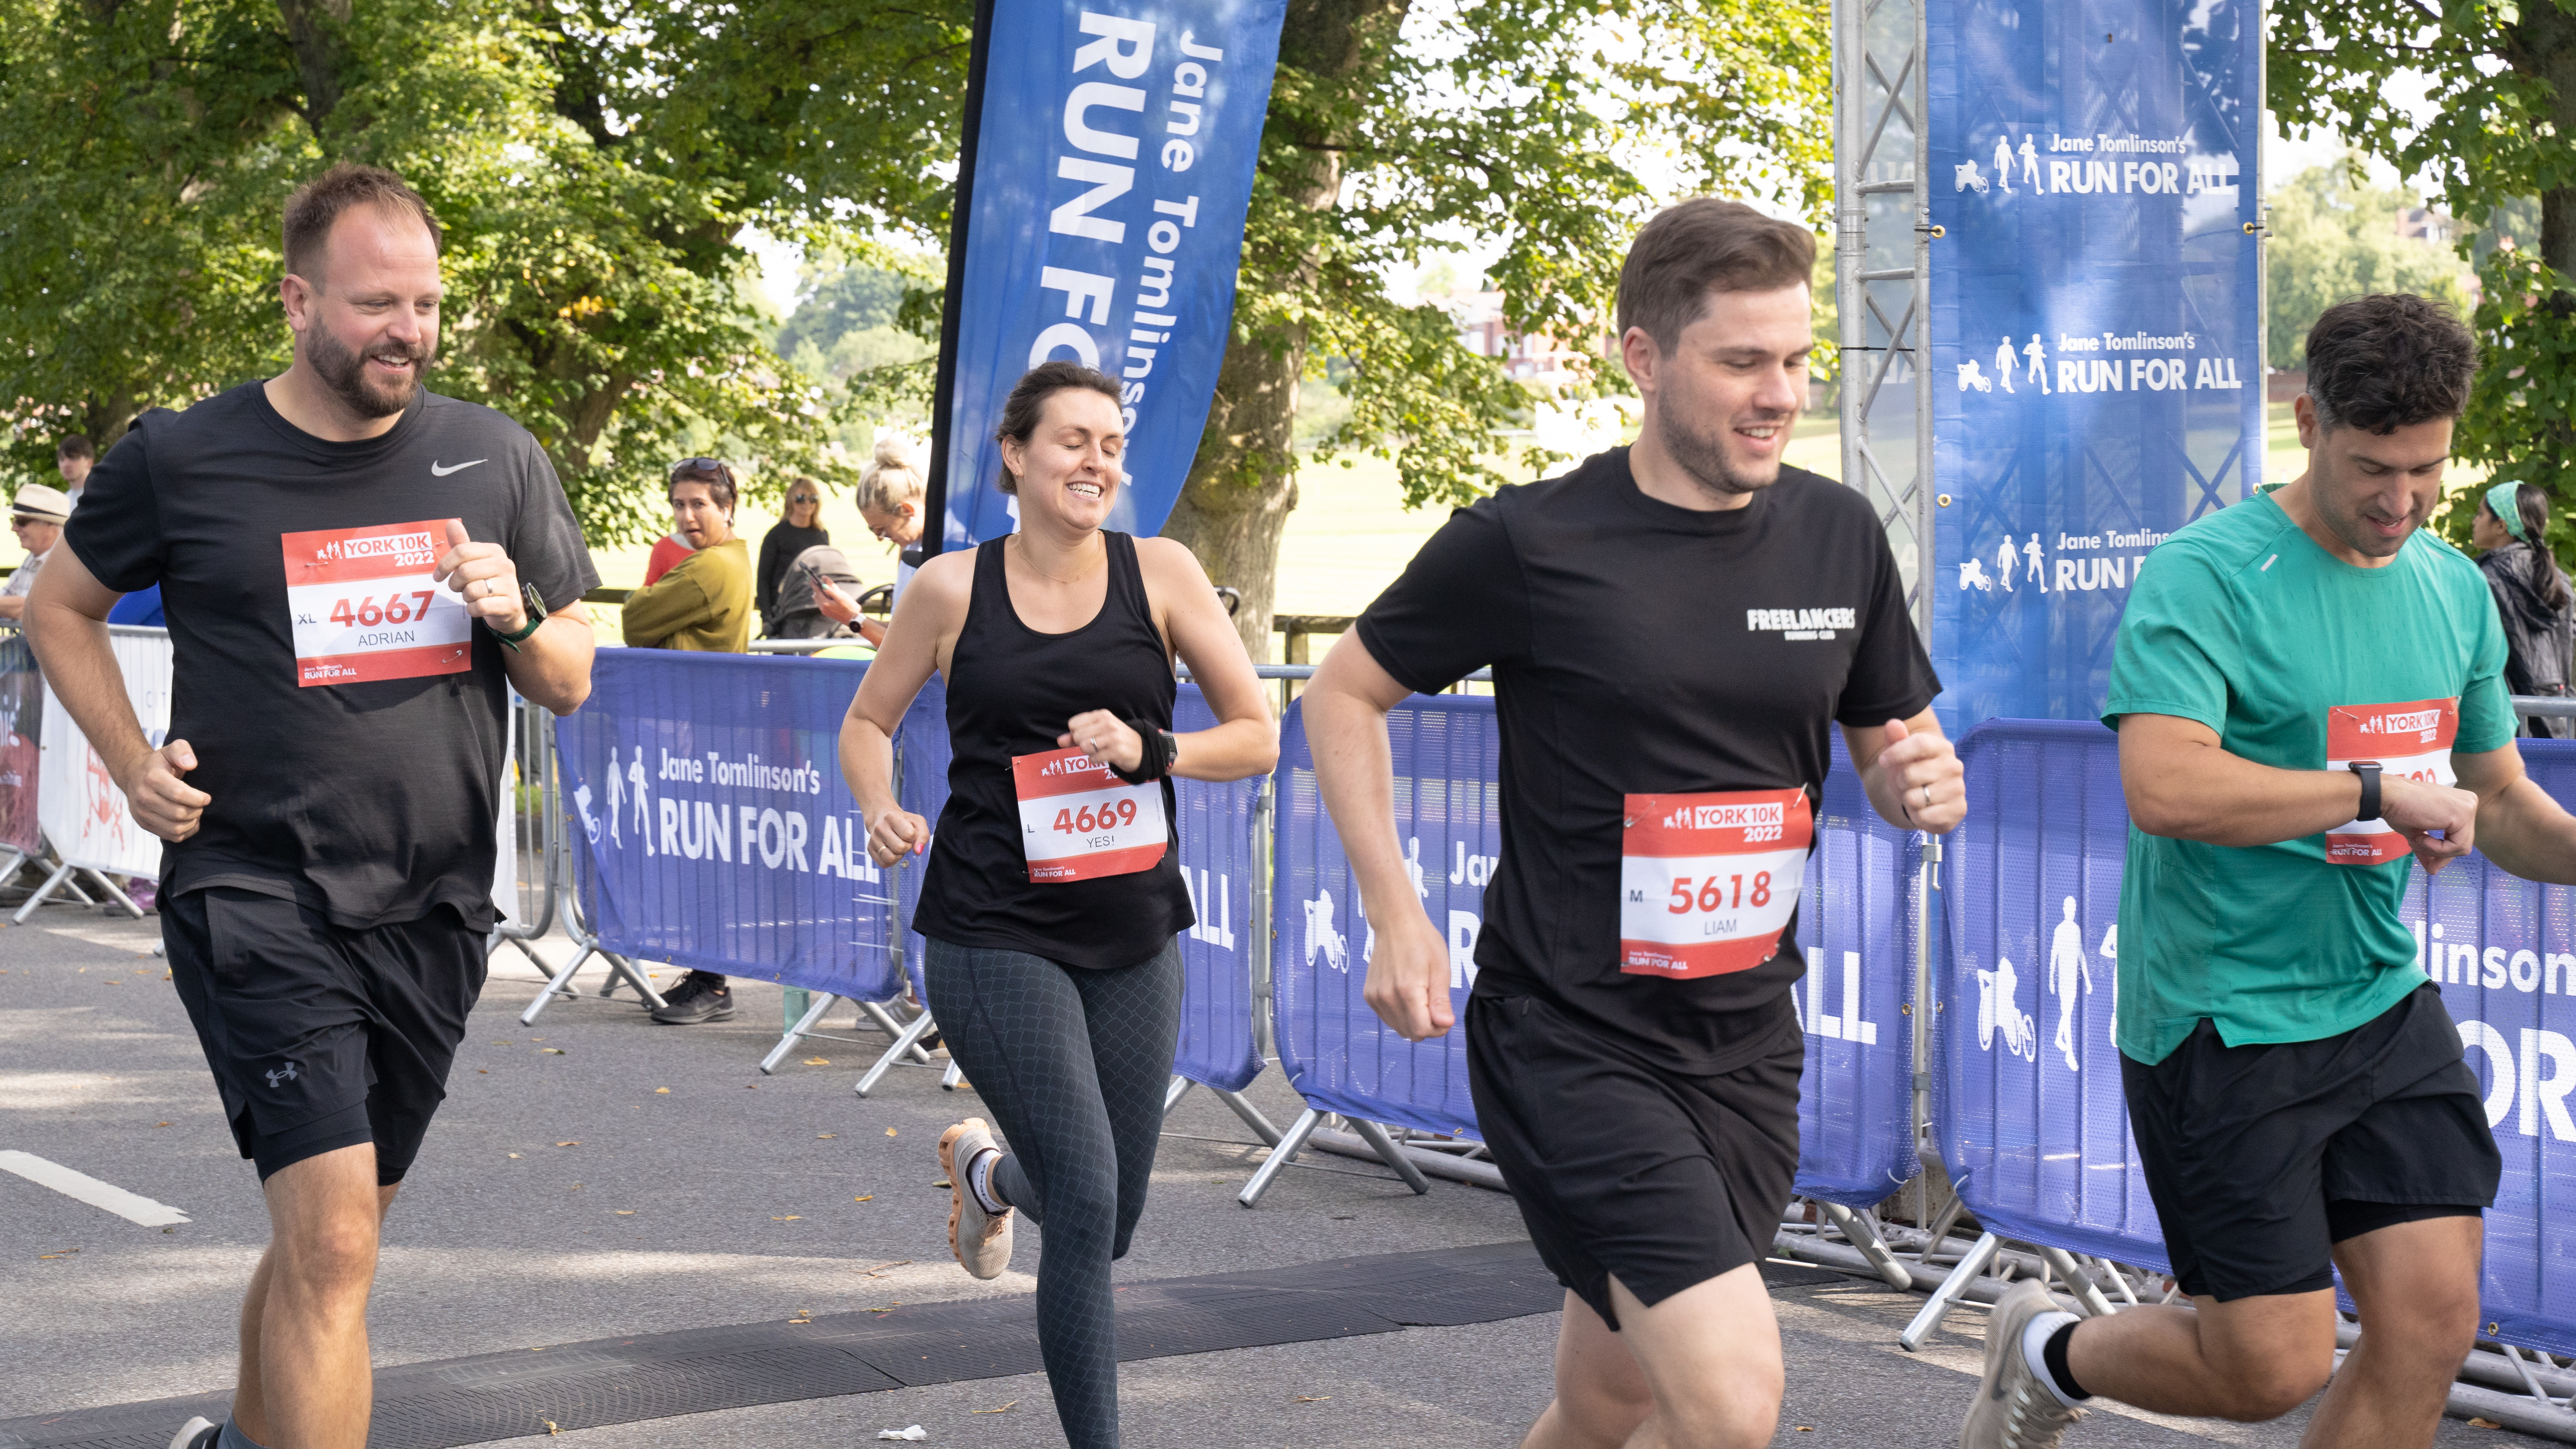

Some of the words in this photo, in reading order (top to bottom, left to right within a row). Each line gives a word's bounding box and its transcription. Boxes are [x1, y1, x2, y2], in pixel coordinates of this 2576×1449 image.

[1161, 30, 1223, 172] Jane
[1049, 11, 1157, 244] RUN
[2050, 133, 2093, 152] Jane
[2097, 133, 2186, 154] Tomlinson's
[2050, 161, 2117, 194] RUN
[2124, 161, 2180, 194] FOR
[2187, 163, 2235, 195] ALL
[1030, 266, 1115, 370] FO
[2058, 333, 2099, 352] Jane
[2103, 331, 2195, 351] Tomlinson's
[2057, 360, 2123, 394] RUN
[2130, 358, 2187, 391] FOR
[2195, 358, 2242, 390] ALL
[346, 539, 395, 555] YORK
[398, 535, 429, 550] 10K
[2057, 532, 2101, 550] Jane
[394, 551, 434, 567] 2022
[2056, 557, 2125, 591] RUN
[298, 614, 317, 624] XL
[330, 590, 436, 627] 4667
[358, 630, 415, 646] ADRIAN
[304, 671, 323, 679] RUN
[324, 669, 340, 677] FOR
[2388, 715, 2423, 731] YORK
[658, 747, 703, 784] Jane
[707, 751, 820, 796] Tomlinson's
[1027, 824, 1035, 834] L
[1053, 798, 1137, 834] 4669
[1698, 809, 1748, 825] YORK
[1751, 806, 1780, 823] 10K
[659, 797, 731, 862] RUN
[740, 806, 810, 873] FOR
[818, 815, 880, 884] ALL
[1086, 836, 1115, 849] YES!
[1744, 826, 1783, 843] 2022
[1630, 890, 1643, 902] M
[1668, 871, 1771, 914] 5618
[1704, 919, 1737, 935] LIAM
[1671, 961, 1689, 970] ALL
[1790, 946, 1877, 1045] LL
[2454, 1020, 2576, 1143] OR
